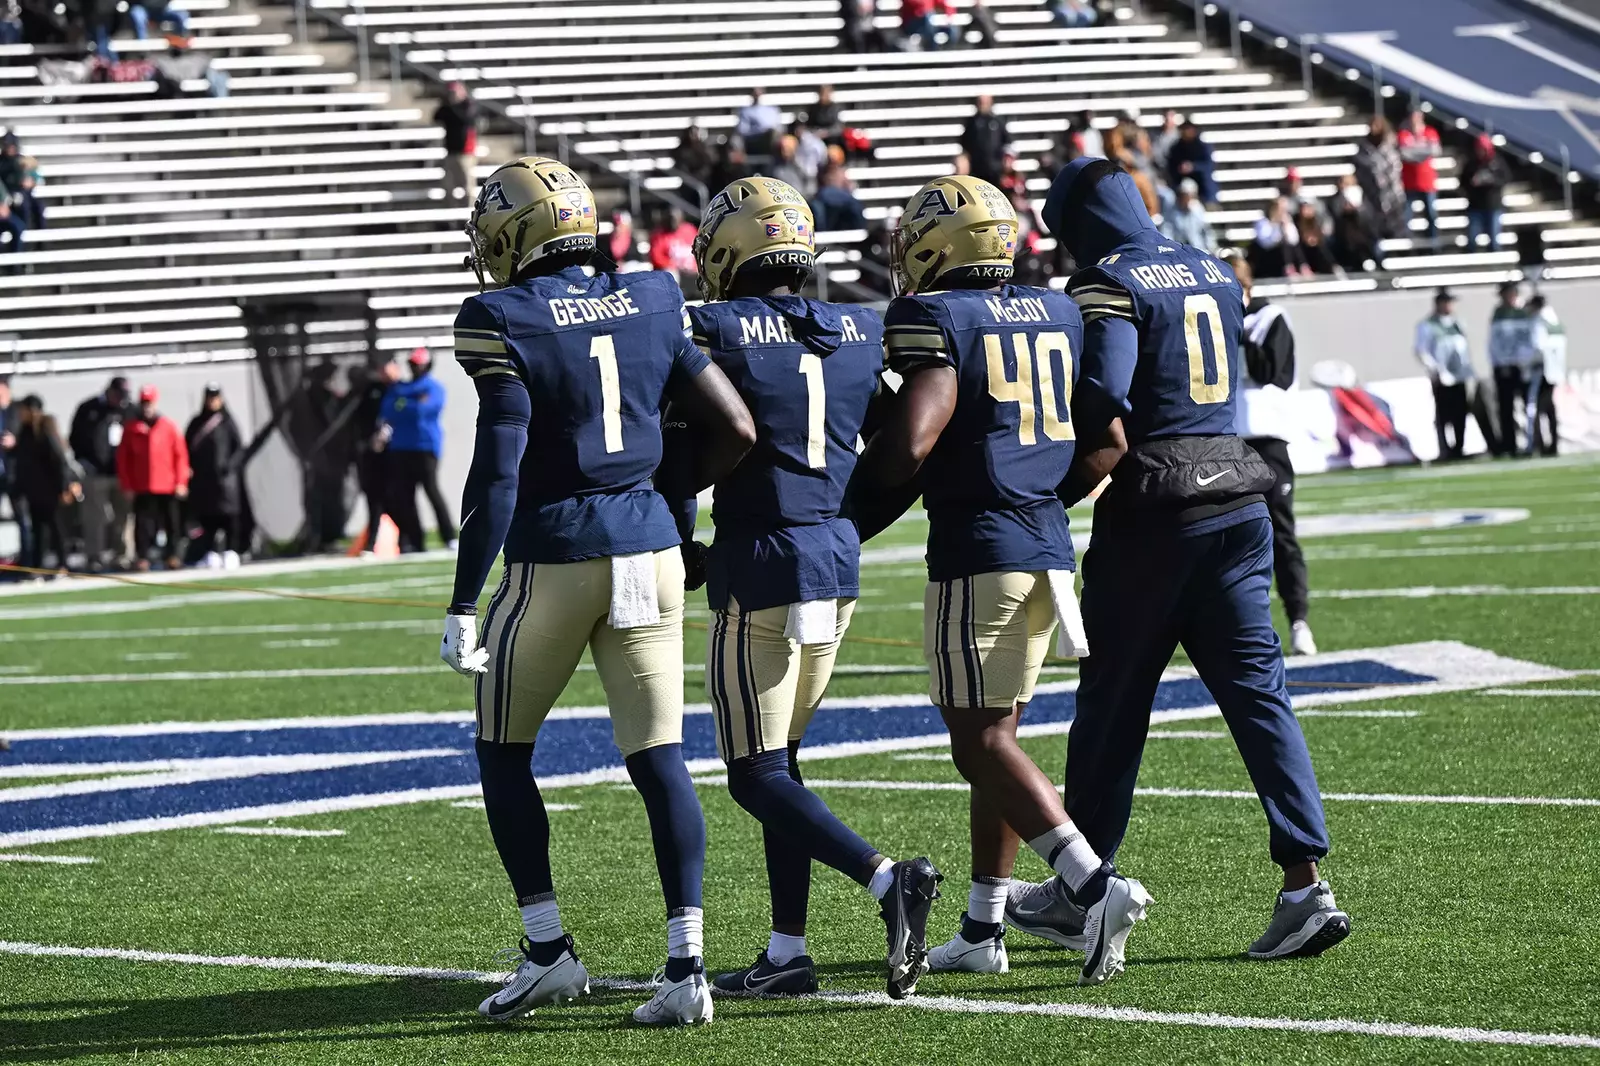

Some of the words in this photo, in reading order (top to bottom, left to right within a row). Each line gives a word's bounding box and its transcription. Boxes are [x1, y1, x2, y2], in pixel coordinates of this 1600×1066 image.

[910, 188, 958, 221] A
[760, 253, 814, 267] AKRON
[1129, 264, 1198, 289] IRONS
[1201, 260, 1232, 283] JR.
[548, 288, 640, 327] GEORGE
[985, 297, 1051, 323] McCOY
[739, 316, 796, 344] MAR
[841, 315, 867, 342] R.
[1184, 294, 1230, 404] 0
[589, 335, 625, 454] 1
[983, 331, 1076, 445] 40
[798, 353, 827, 469] 1
